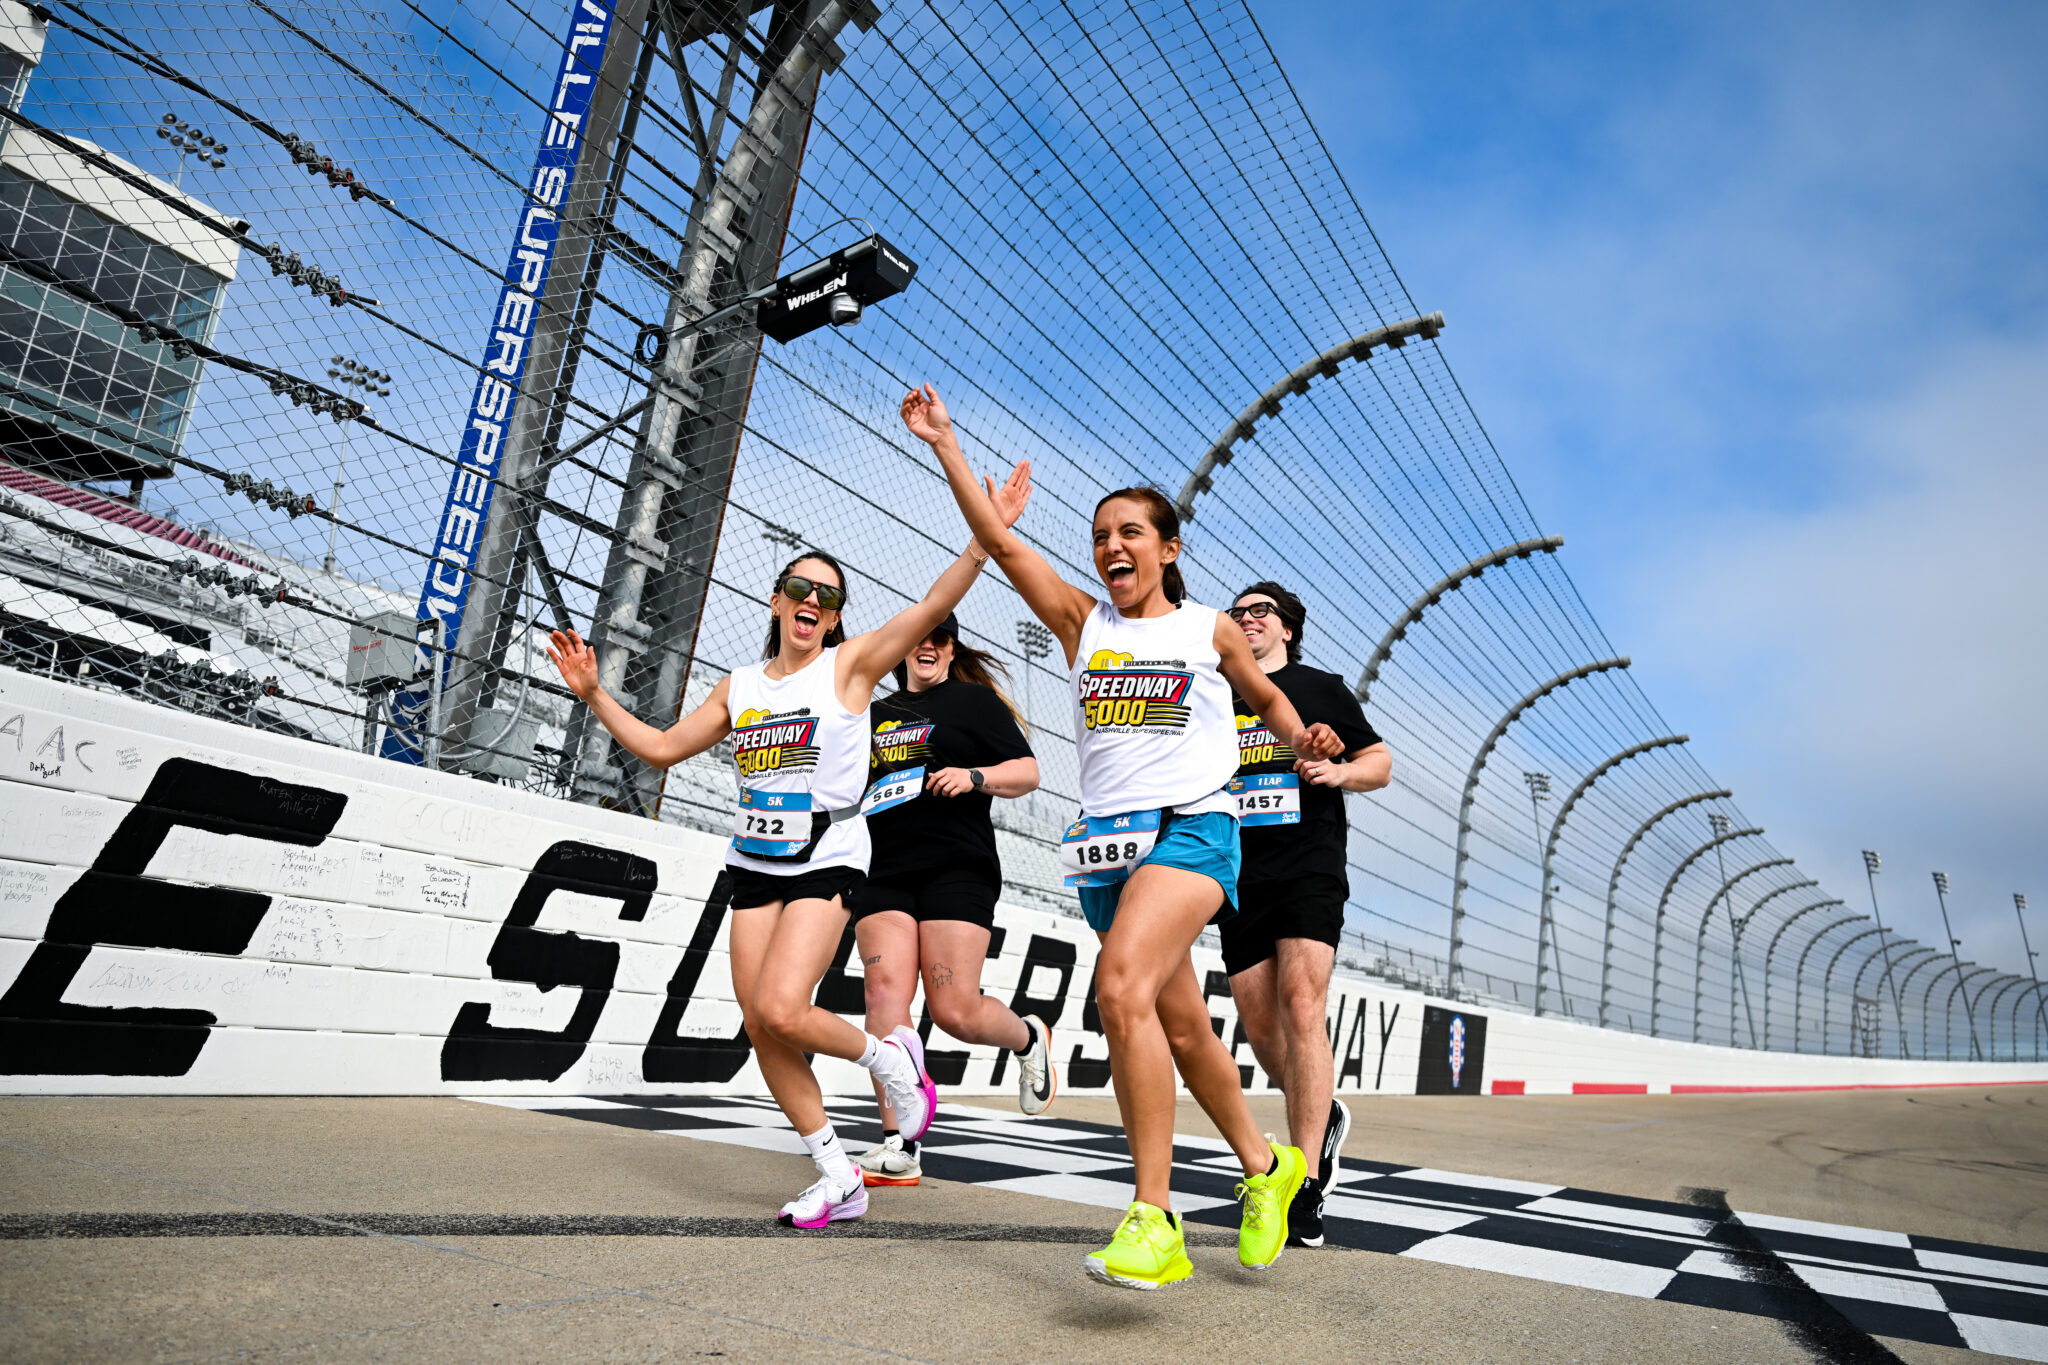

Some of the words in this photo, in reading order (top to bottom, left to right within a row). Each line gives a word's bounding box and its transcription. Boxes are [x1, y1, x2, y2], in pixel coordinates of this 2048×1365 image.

[882, 247, 910, 274] WHELEN
[786, 271, 849, 312] WHELEN
[1079, 673, 1182, 700] SPEEDWAY
[1084, 699, 1148, 731] 5000
[731, 723, 808, 753] SPEEDWAY
[873, 727, 926, 748] PEEDWAY
[1095, 727, 1131, 735] NASHVILLE
[735, 746, 782, 777] 5000
[1239, 745, 1274, 766] 000
[894, 771, 911, 781] LAP
[1258, 778, 1263, 786] 1
[1263, 777, 1283, 786] LAP
[767, 796, 784, 807] 5K
[873, 785, 905, 803] 568
[1238, 795, 1284, 811] 1457
[746, 814, 785, 835] 722
[1113, 816, 1131, 829] 5K
[1076, 841, 1138, 866] 1888
